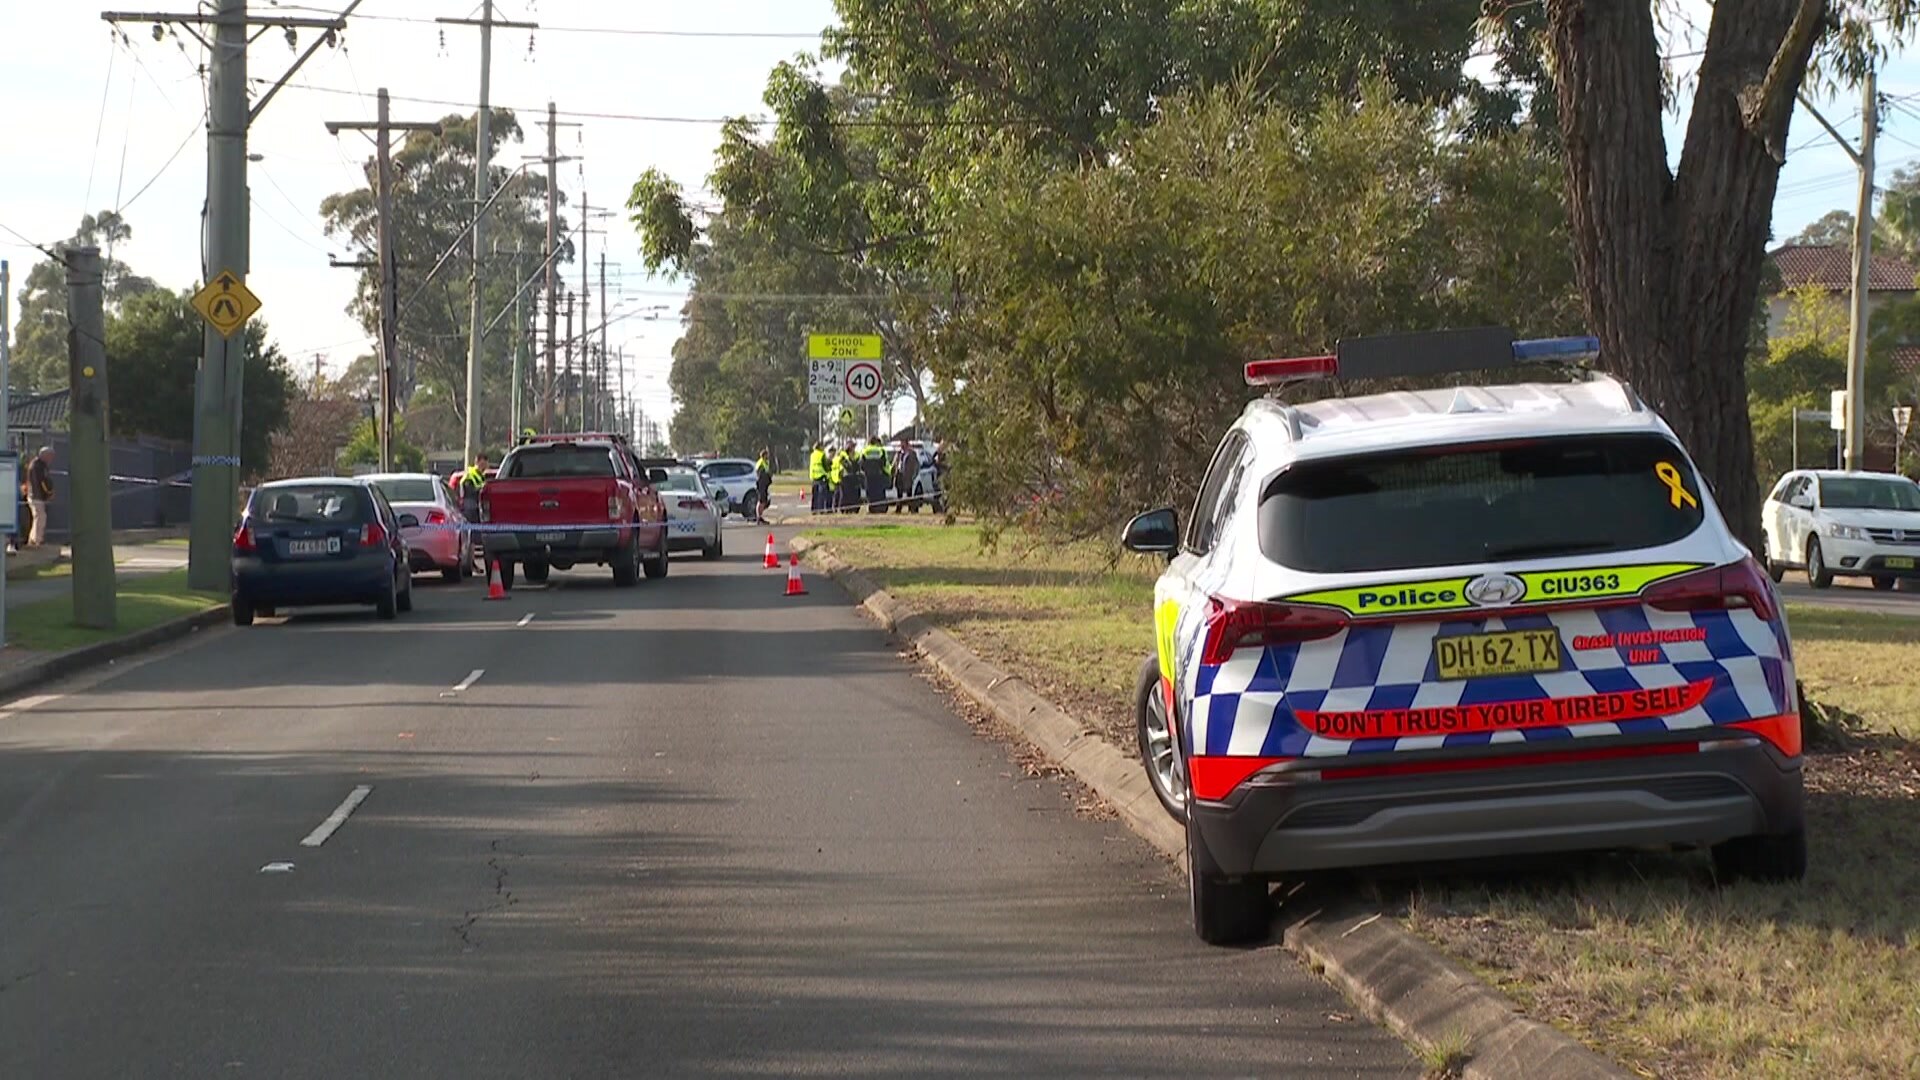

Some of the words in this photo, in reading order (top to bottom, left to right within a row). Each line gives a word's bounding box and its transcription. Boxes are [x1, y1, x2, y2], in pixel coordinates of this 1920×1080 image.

[825, 337, 864, 346] SCHOOL
[831, 347, 858, 356] ZONE
[851, 373, 875, 390] 40
[1358, 589, 1457, 609] Police
[1541, 574, 1620, 594] CIU363
[1572, 634, 1615, 651] CRASH
[1617, 627, 1707, 646] INVESTIGATION
[1628, 648, 1660, 664] UNIT
[1315, 713, 1384, 735] DON'T
[1394, 707, 1471, 732] TRUST
[1477, 701, 1545, 728] YOUR
[1549, 693, 1625, 721] TIRED
[1631, 685, 1691, 713] SELF
